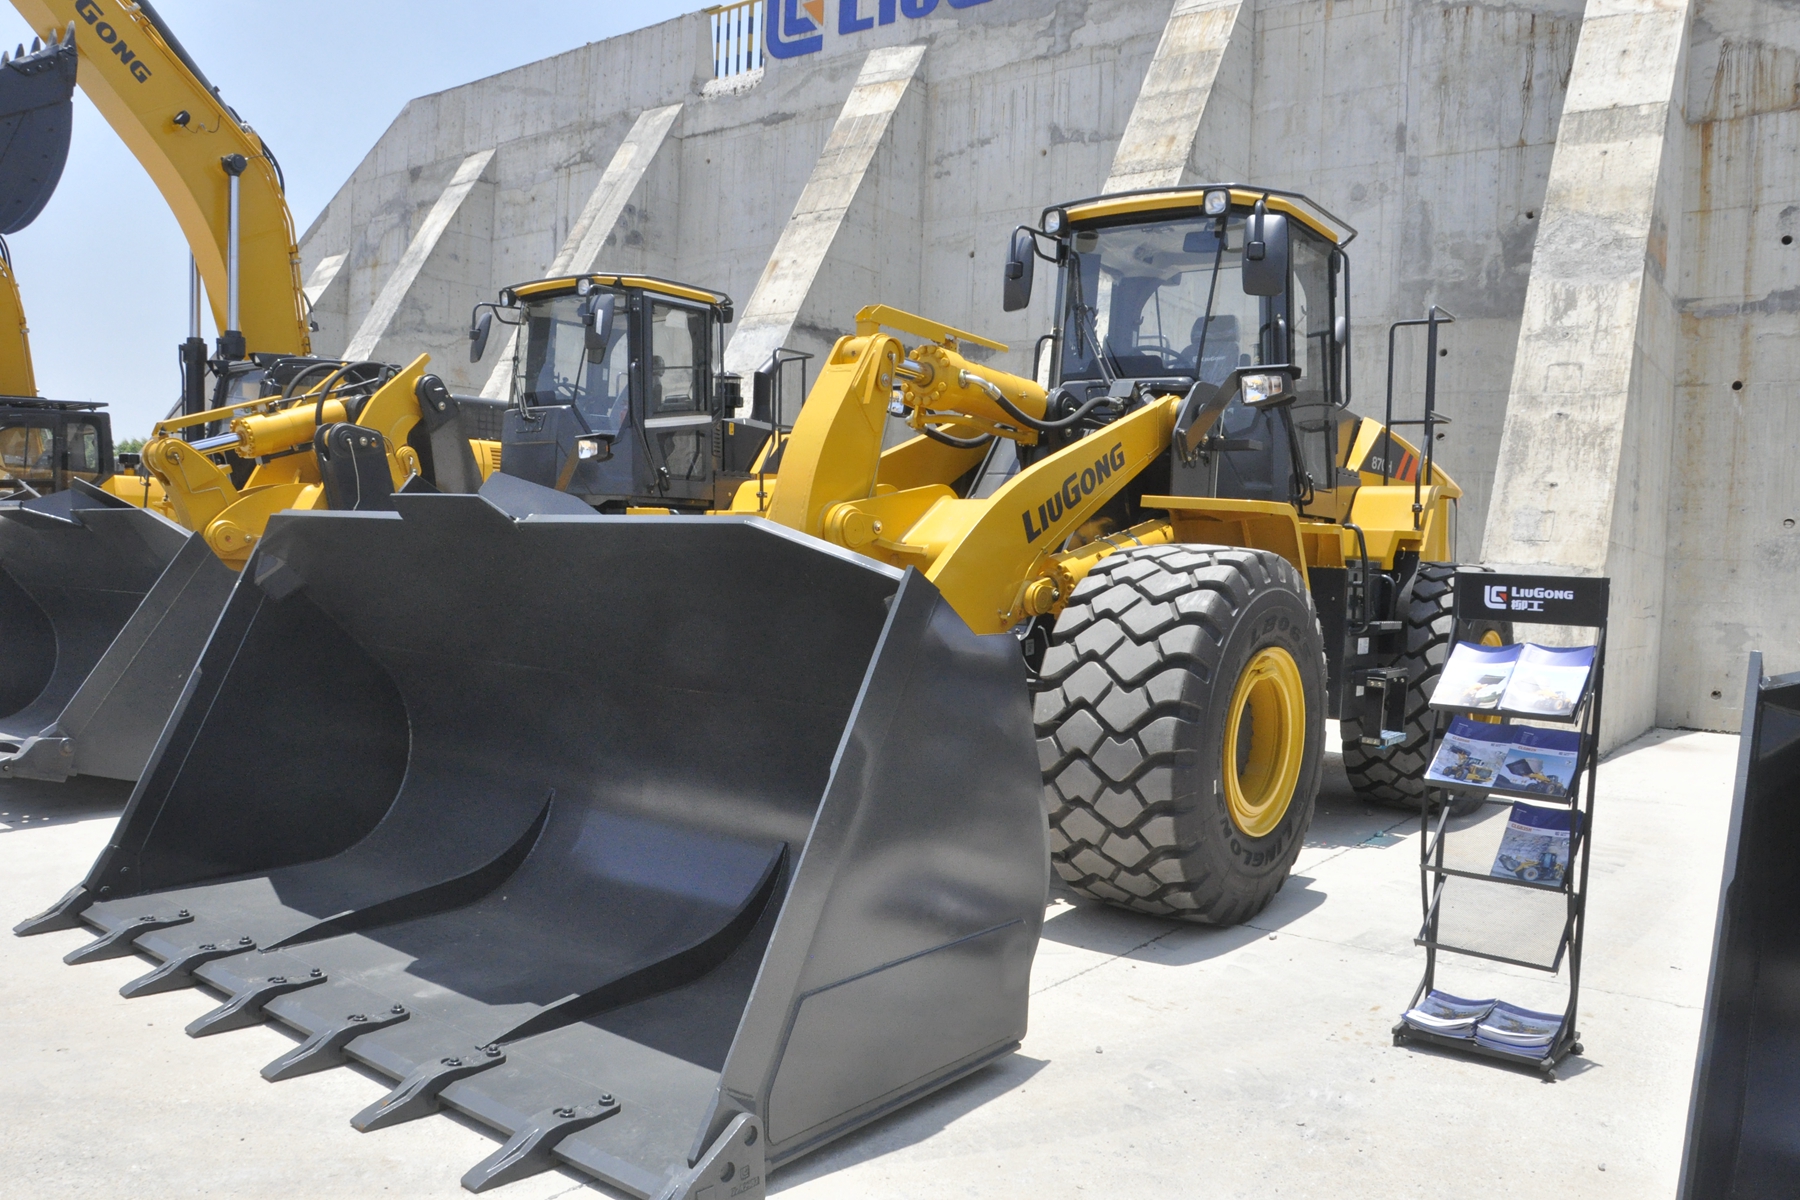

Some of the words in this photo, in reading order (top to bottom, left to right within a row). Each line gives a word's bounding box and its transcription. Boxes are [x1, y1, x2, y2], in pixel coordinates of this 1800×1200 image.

[1022, 442, 1125, 544] LIUGONG
[1511, 586, 1574, 600] LIUGONG
[1511, 600, 1544, 611] 柳工
